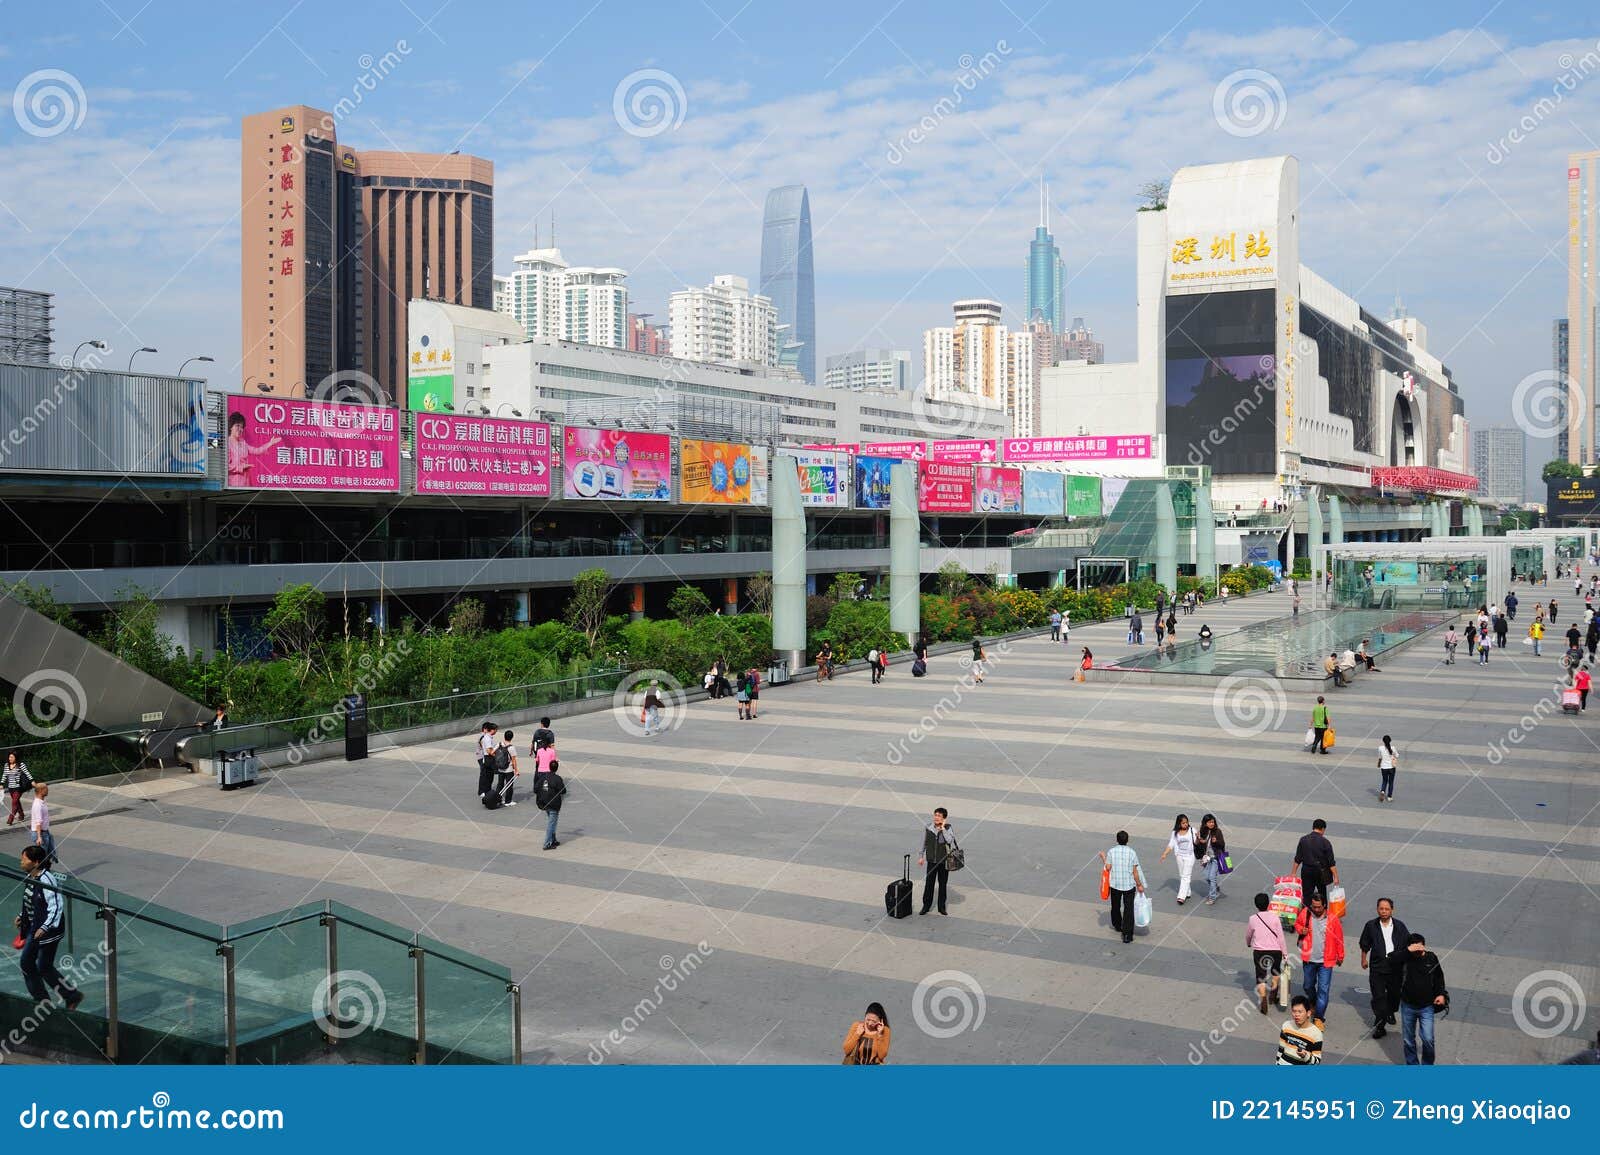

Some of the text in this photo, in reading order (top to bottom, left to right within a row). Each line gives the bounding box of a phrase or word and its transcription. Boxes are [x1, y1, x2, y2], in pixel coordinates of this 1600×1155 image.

[281, 143, 294, 276] 富临大酒店
[1172, 230, 1272, 264] 深圳站
[291, 406, 394, 432] 爱康健齿科集团
[454, 422, 546, 446] 爱康健齿科集团
[276, 446, 384, 468] 富康口腔门诊部
[438, 443, 479, 452] PROFESSIONAL
[480, 445, 501, 454] DENTAL
[502, 447, 528, 455] HOSPITAL
